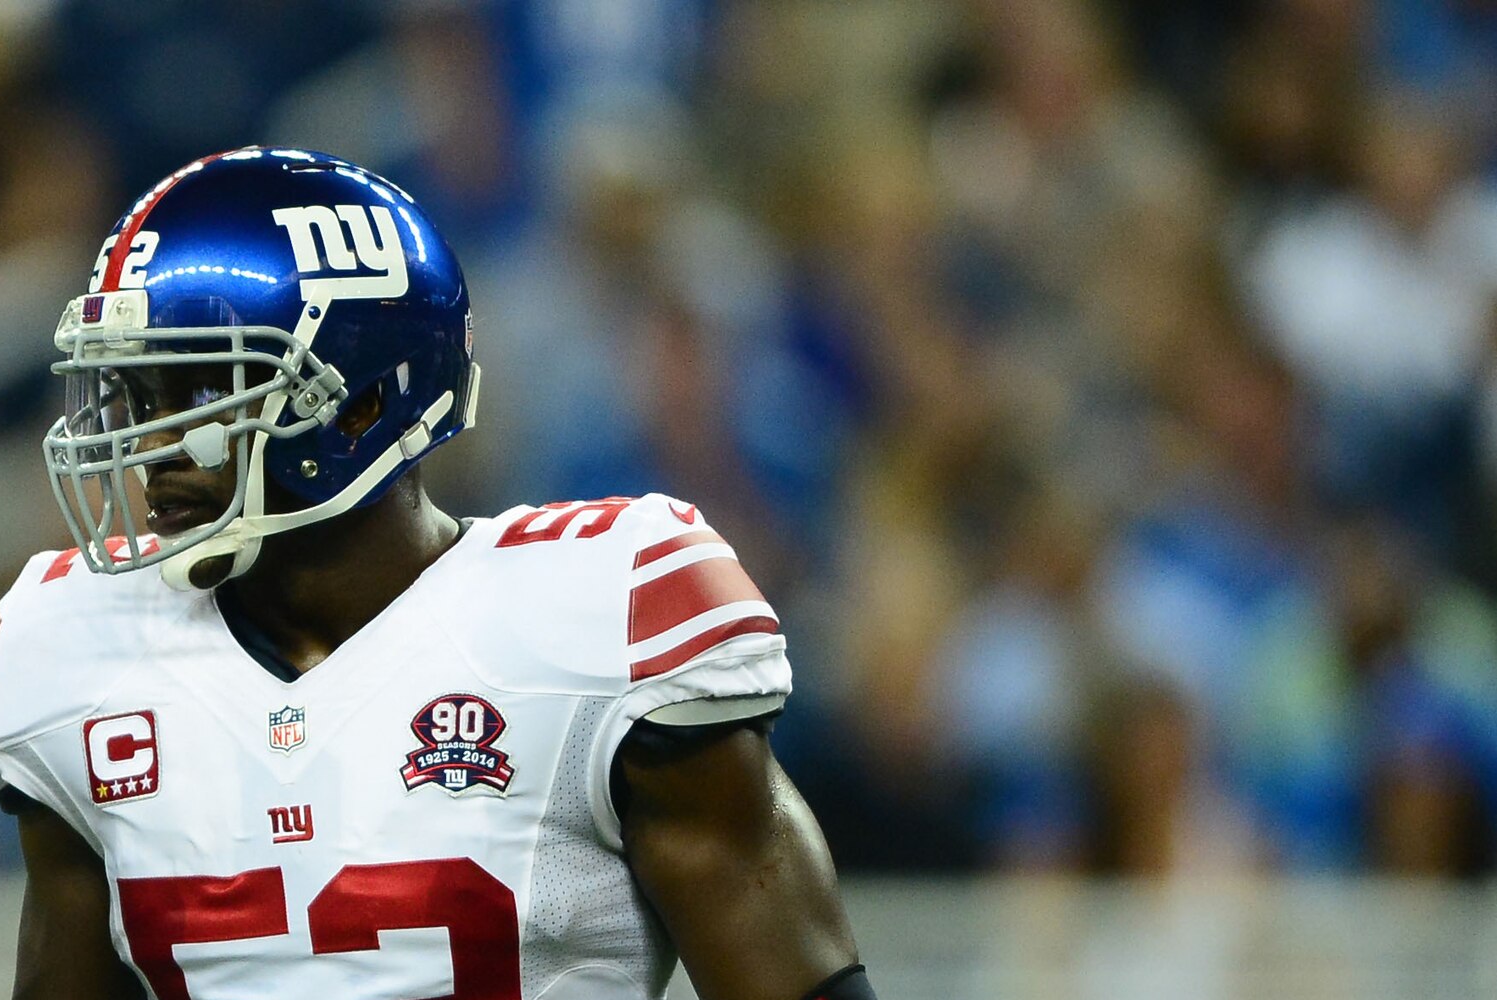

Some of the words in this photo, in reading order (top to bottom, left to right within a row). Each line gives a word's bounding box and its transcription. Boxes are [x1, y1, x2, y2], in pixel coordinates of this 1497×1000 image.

[88, 230, 160, 294] 52
[271, 204, 409, 302] ny
[271, 724, 303, 748] NFL
[431, 701, 484, 742] 90
[88, 714, 155, 781] C
[417, 750, 449, 768] 1925
[462, 750, 496, 769] 2014
[437, 742, 477, 750] SEASONS
